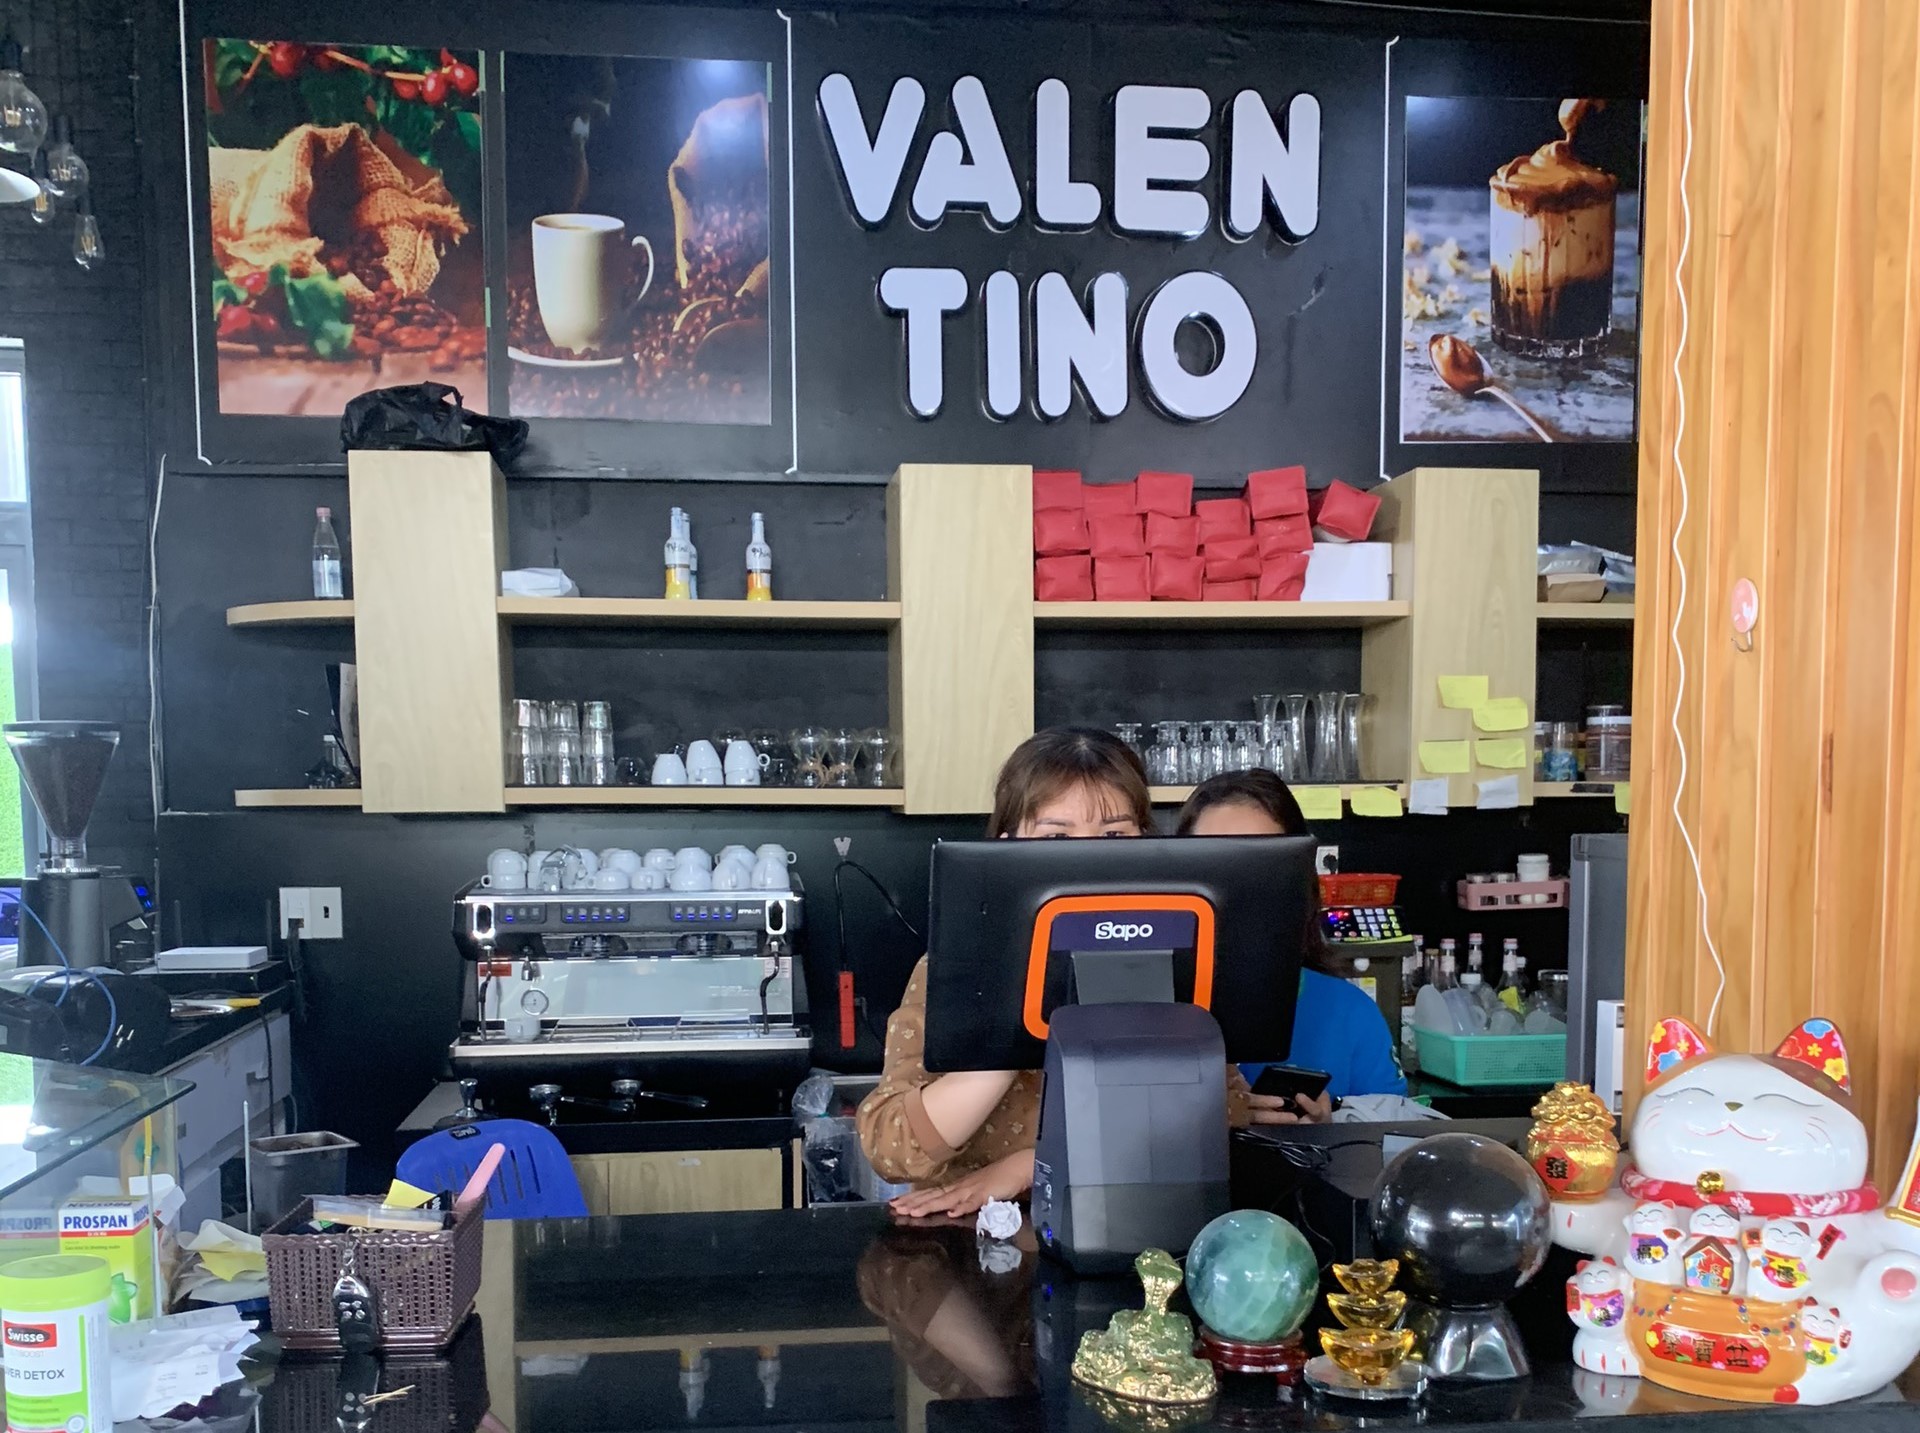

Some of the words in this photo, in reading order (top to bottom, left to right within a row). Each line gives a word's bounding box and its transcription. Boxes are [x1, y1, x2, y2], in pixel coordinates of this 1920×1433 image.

[817, 73, 1321, 243] VALEN
[877, 267, 1258, 422] TINO
[1095, 921, 1153, 941] Sapo
[63, 1214, 128, 1230] PROSPAN
[7, 1327, 45, 1343] Swisse
[23, 1369, 65, 1381] DETOX
